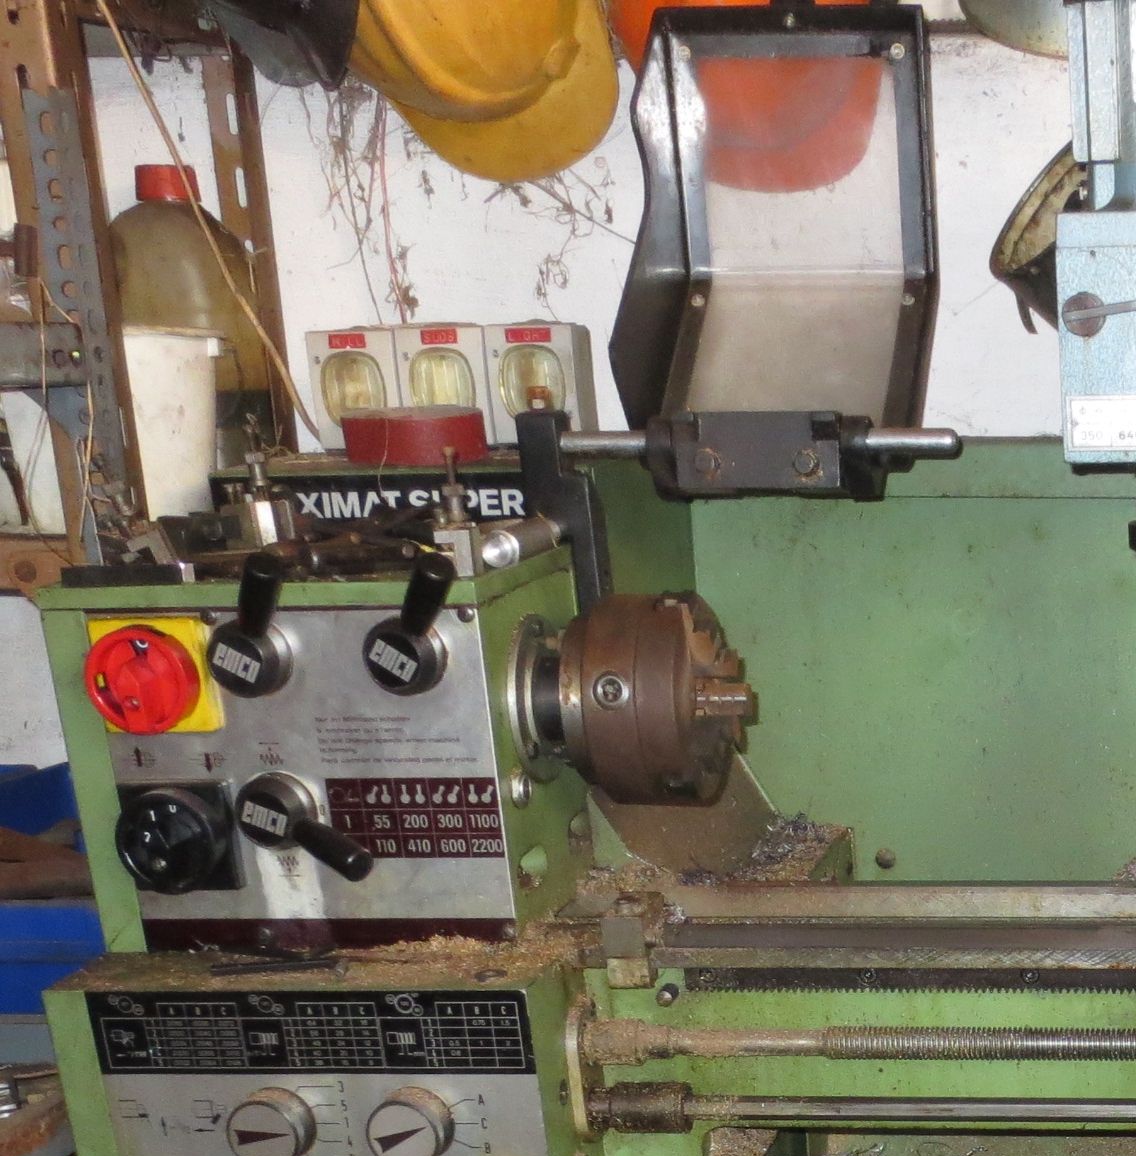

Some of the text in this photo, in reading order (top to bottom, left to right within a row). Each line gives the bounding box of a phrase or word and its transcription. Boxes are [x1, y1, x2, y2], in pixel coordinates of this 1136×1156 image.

[374, 814, 391, 829] 55
[402, 814, 428, 829] 200
[437, 814, 463, 829] 300
[470, 814, 499, 829] 1100
[376, 839, 504, 854] 110 410 600 2200
[446, 1006, 507, 1015] A B C
[337, 1081, 345, 1092] 3
[341, 1100, 348, 1111] 5
[478, 1094, 485, 1106] A
[481, 1118, 488, 1129] C
[484, 1142, 491, 1153] B
